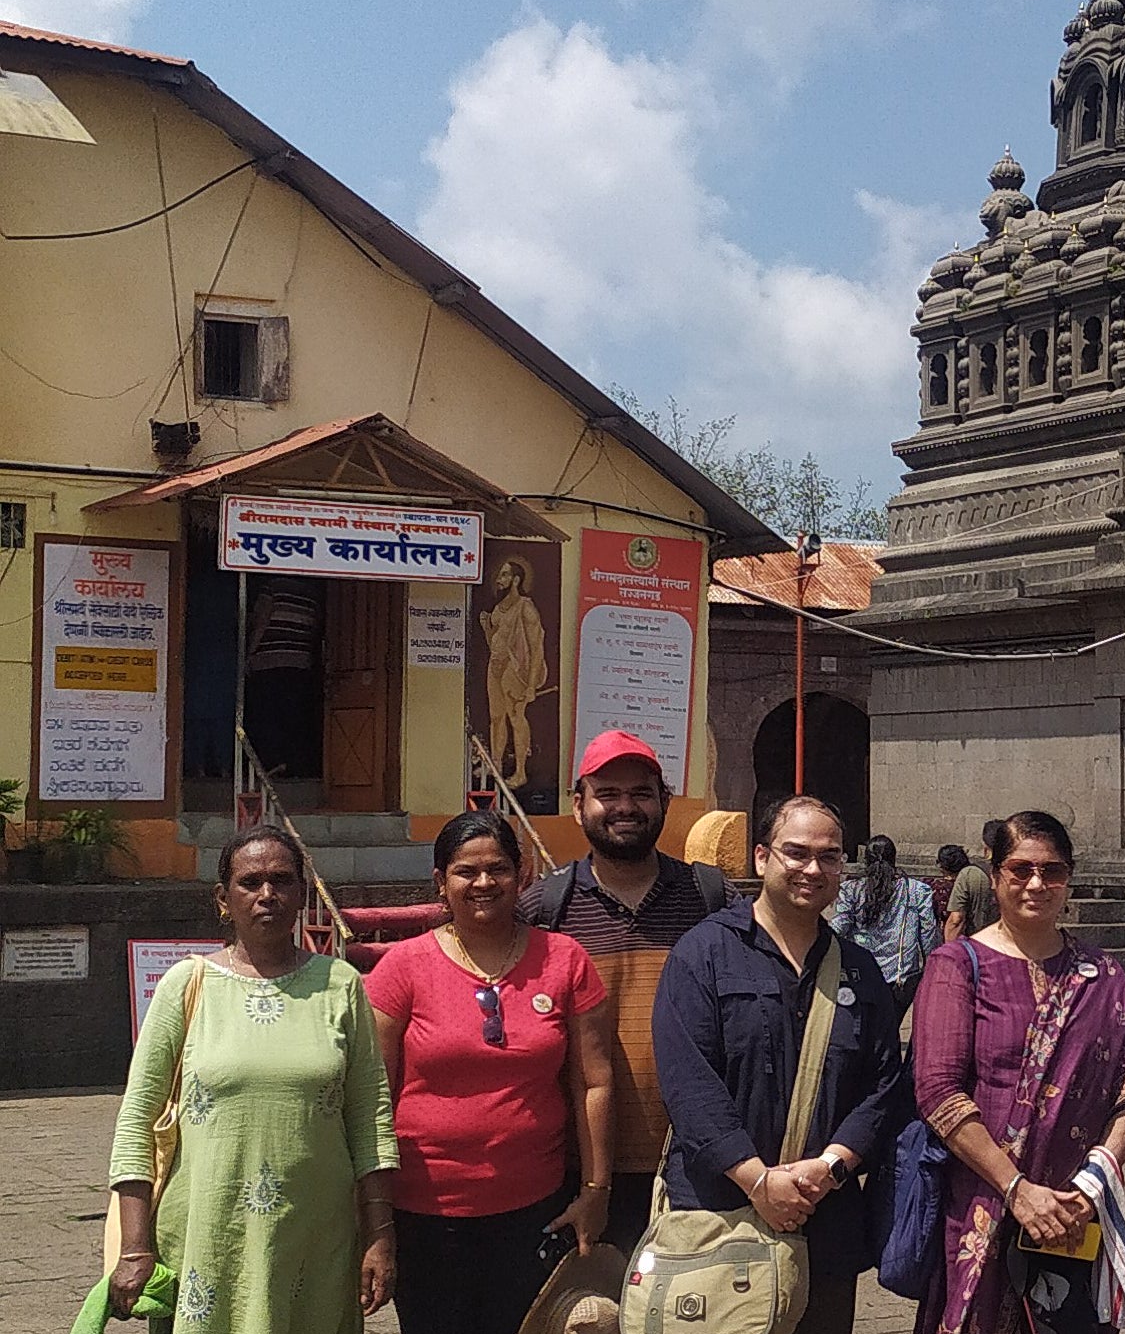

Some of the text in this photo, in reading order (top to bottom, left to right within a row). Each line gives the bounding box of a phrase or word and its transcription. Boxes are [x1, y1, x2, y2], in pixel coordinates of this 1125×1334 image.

[238, 509, 305, 527] श्रीरामदास
[308, 515, 349, 529] स्वामी
[237, 531, 464, 567] मुख्य कार्यालय
[89, 551, 134, 576] मुख्य
[73, 576, 147, 599] कार्यालय
